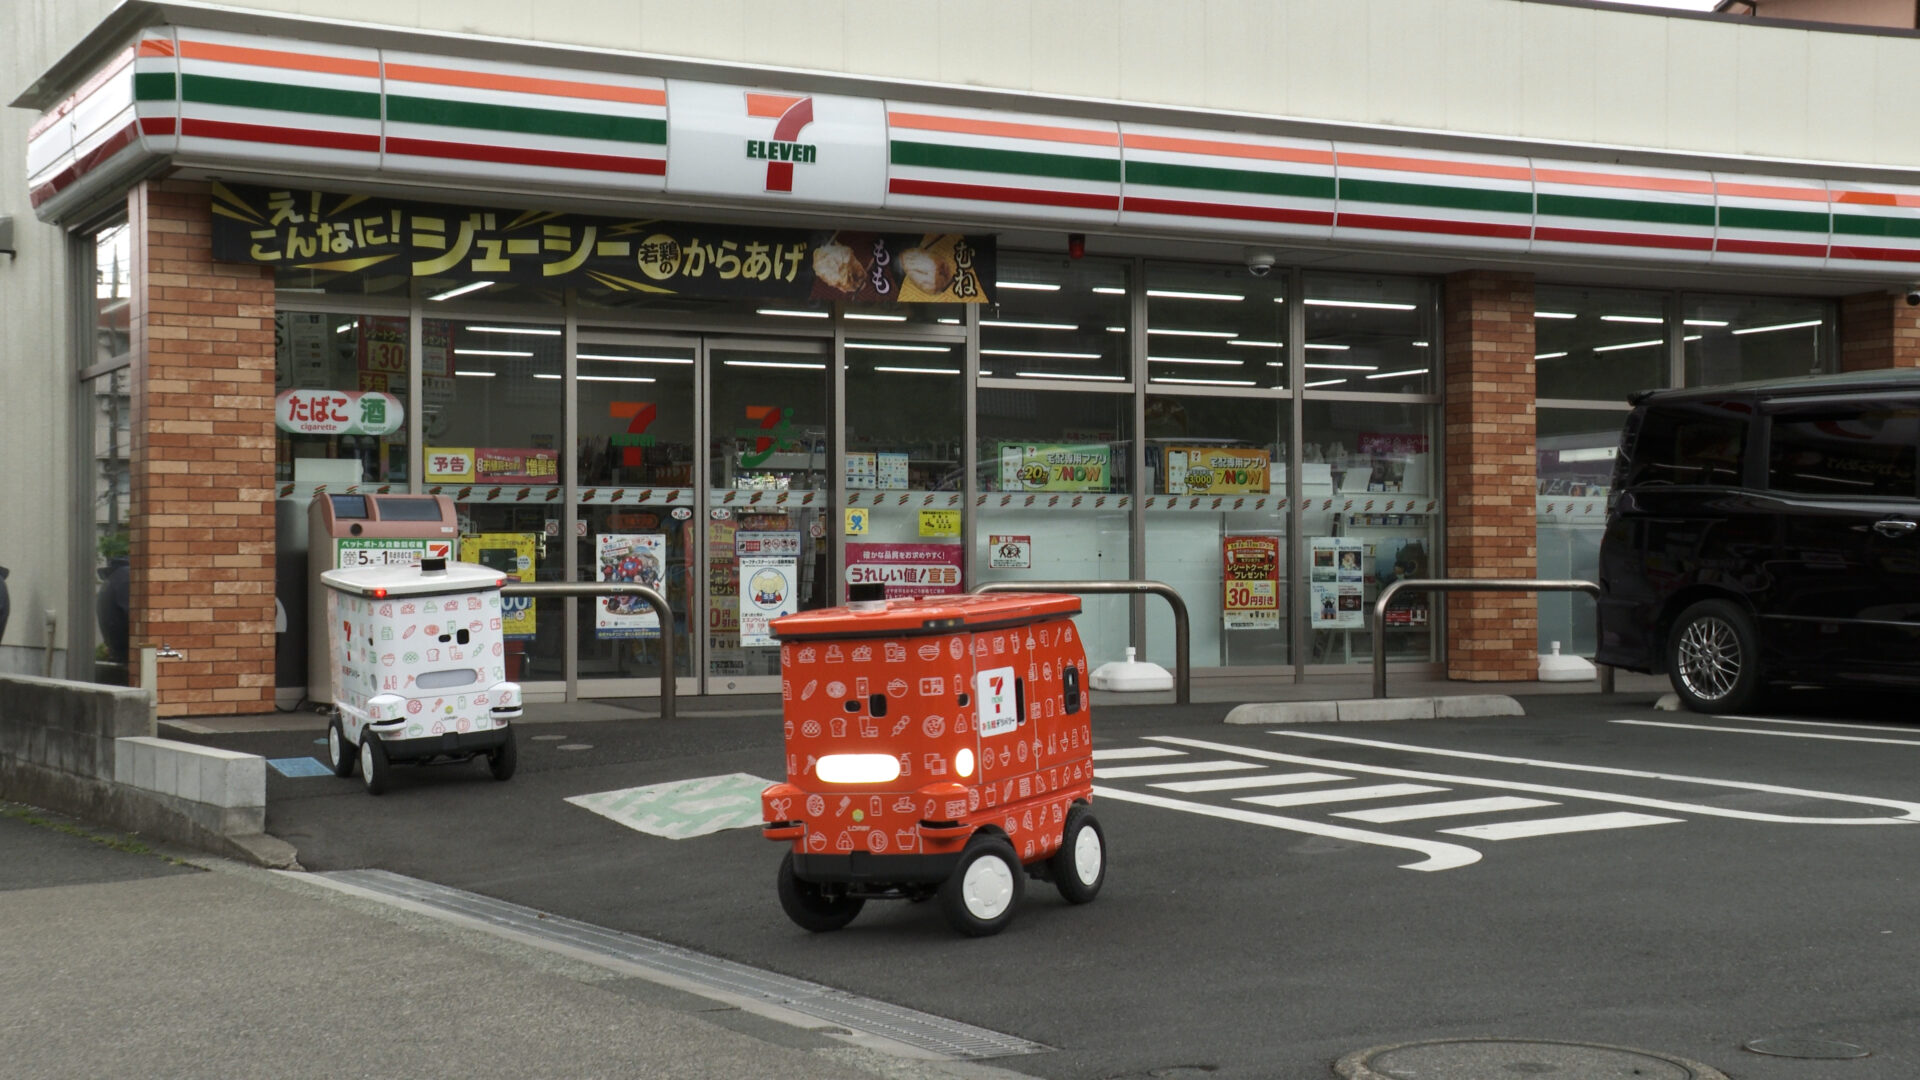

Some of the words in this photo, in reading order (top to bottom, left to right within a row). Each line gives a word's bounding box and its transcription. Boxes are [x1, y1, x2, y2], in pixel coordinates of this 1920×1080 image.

[745, 92, 814, 192] 7
[269, 190, 322, 226] え!
[249, 209, 402, 261] こんなに!
[411, 212, 631, 277] ジューシー
[639, 240, 680, 276] 若鶏の
[681, 238, 806, 282] からあげ
[872, 239, 891, 295] もも
[953, 240, 977, 297] むね
[288, 395, 349, 423] たばこ
[360, 398, 386, 425] 酒
[300, 423, 337, 432] cigarette
[433, 456, 465, 473] 予告
[1047, 452, 1107, 465] 宅配専用アプリ
[1211, 457, 1268, 469] 宅配専用アプリ
[1054, 466, 1101, 482] 7NOW
[1216, 469, 1262, 485] 7NOW
[851, 567, 957, 584] うれしい値!宣言
